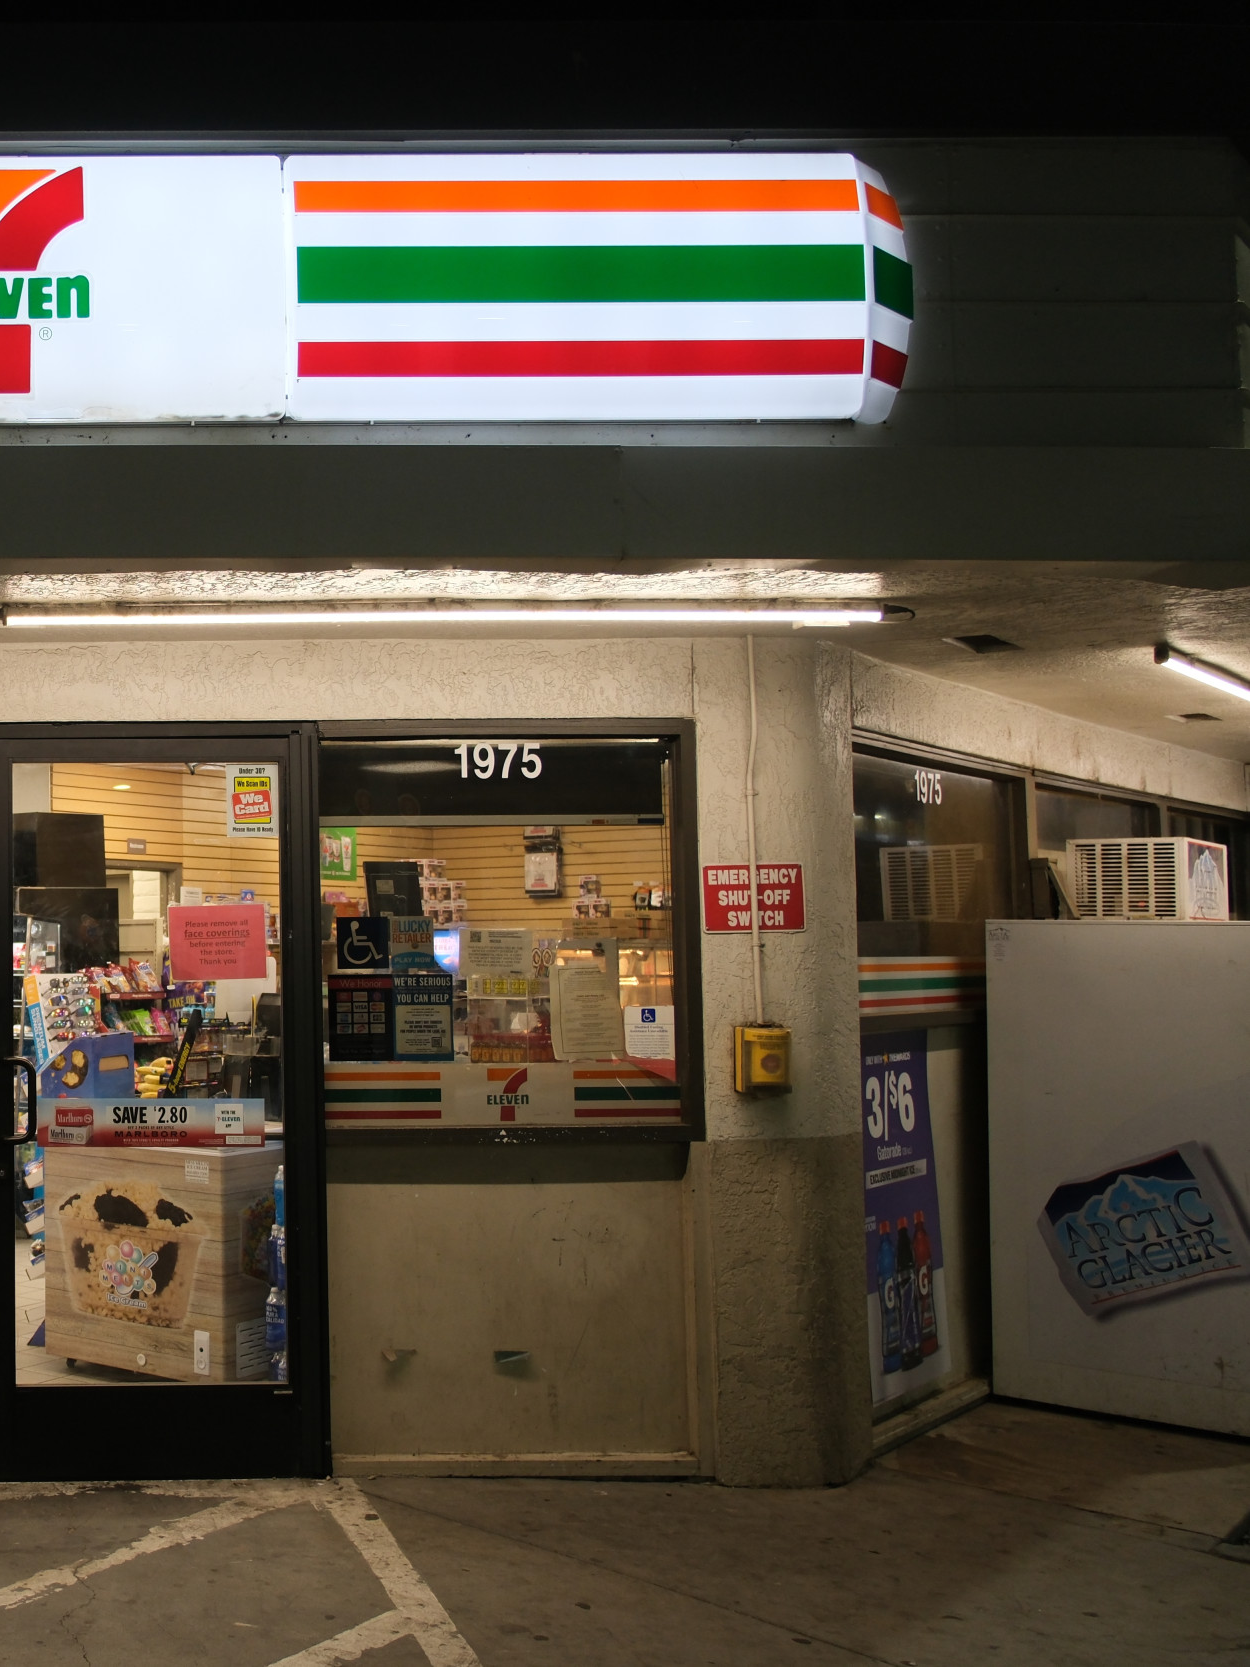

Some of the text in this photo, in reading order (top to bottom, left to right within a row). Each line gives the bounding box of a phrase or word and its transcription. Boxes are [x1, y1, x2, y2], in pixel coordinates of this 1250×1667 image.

[454, 742, 542, 779] 1975
[914, 770, 942, 805] 1975
[239, 793, 263, 804] We
[235, 802, 269, 814] Card
[727, 911, 784, 926] SWTCH
[206, 928, 250, 937] coverings
[398, 920, 430, 933] LUCKY
[392, 933, 432, 944] RETAILER
[340, 979, 382, 987] We Honor
[394, 977, 451, 986] WE'RE SERIOUS
[396, 994, 449, 1003] YOU CAN HELP
[177, 1042, 191, 1071] ENERGY
[487, 1067, 528, 1121] 7
[865, 1070, 915, 1141] 3/$6
[57, 1113, 83, 1123] Marlboro
[113, 1107, 147, 1123] SAVE
[51, 1129, 74, 1138] Marlboro
[877, 1142, 902, 1160] Gatorade
[1065, 1186, 1214, 1259] ARCTIC
[1077, 1228, 1232, 1288] GLACIER
[106, 1264, 146, 1275] MINI
[103, 1275, 152, 1290] MELTS
[1094, 1273, 1188, 1300] PREMIUM
